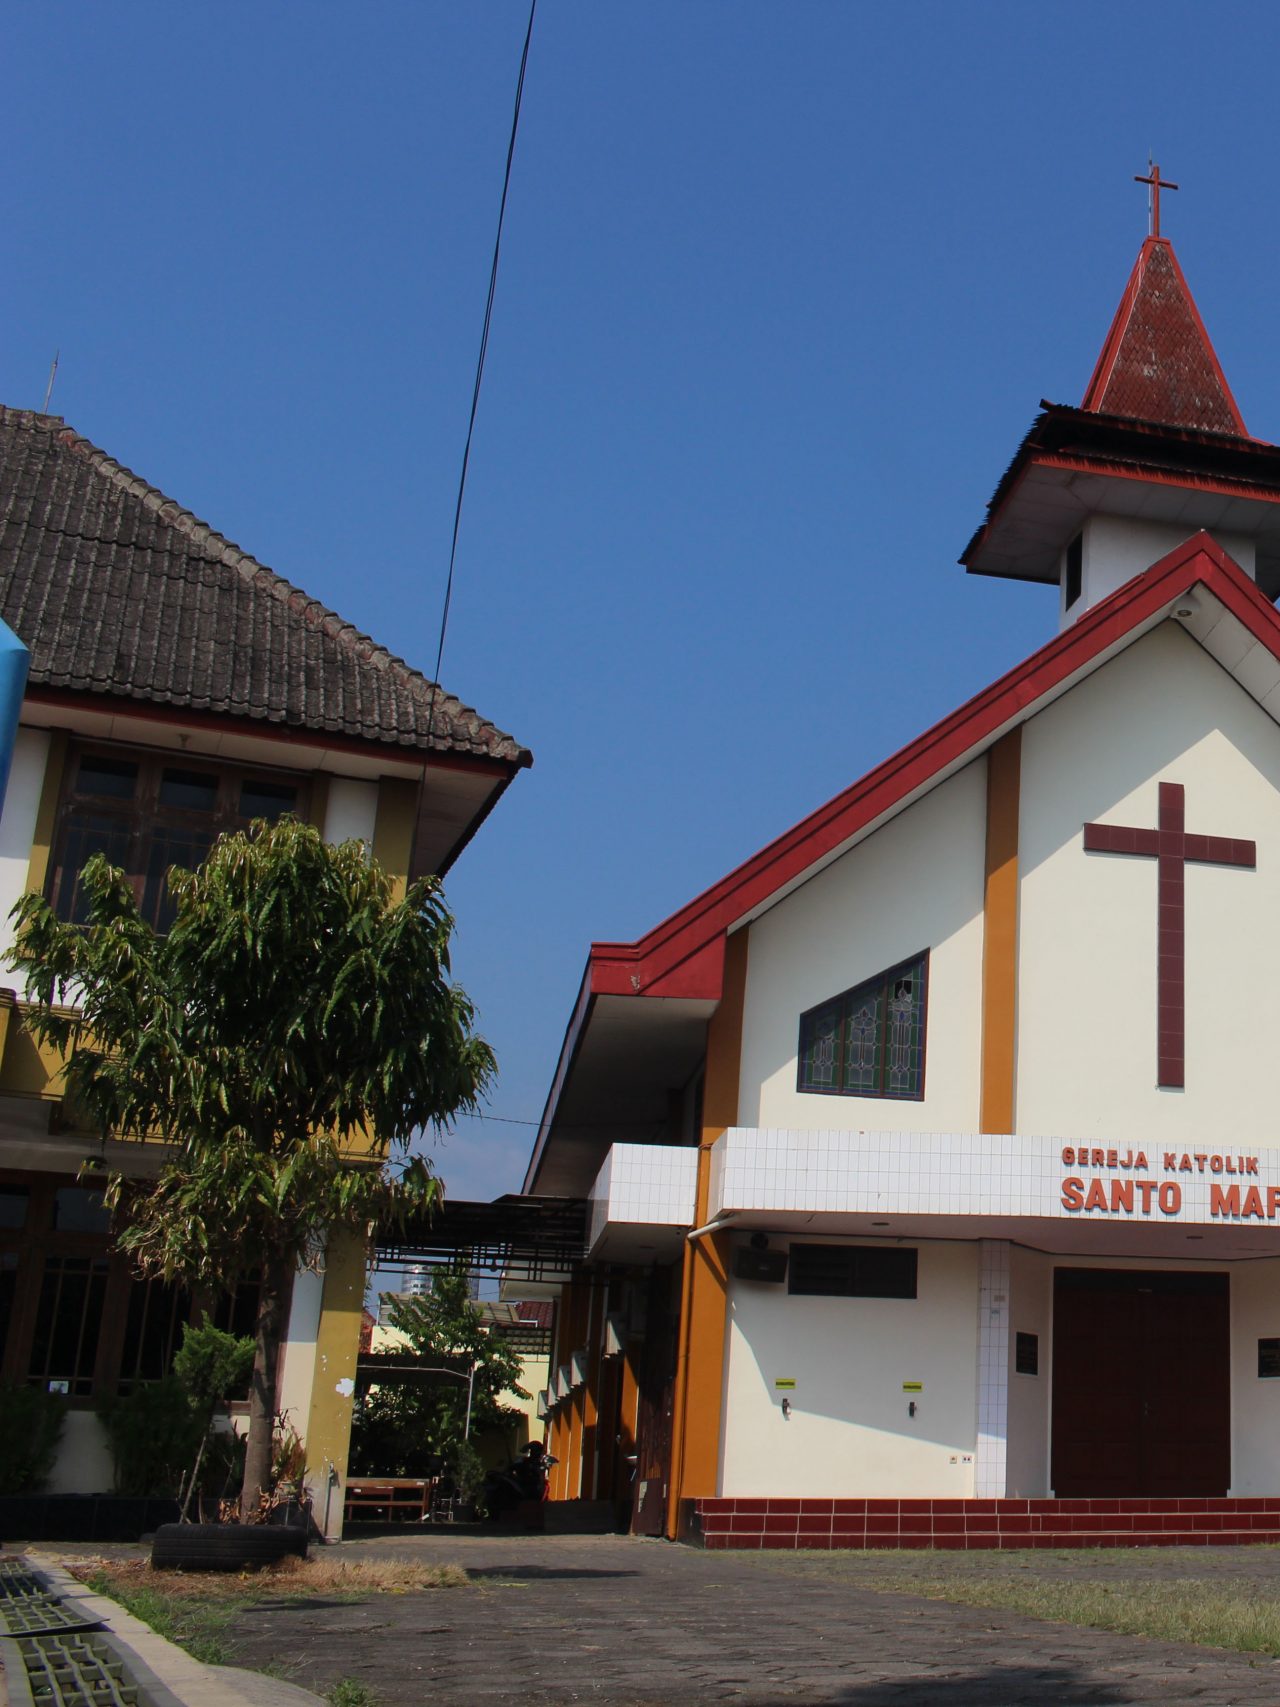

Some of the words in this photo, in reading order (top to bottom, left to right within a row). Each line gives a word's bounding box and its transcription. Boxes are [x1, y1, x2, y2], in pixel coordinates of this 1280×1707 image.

[1062, 1146, 1149, 1168] GEREJA
[1163, 1151, 1259, 1173] KATOLIK
[1061, 1176, 1182, 1213] SANTO
